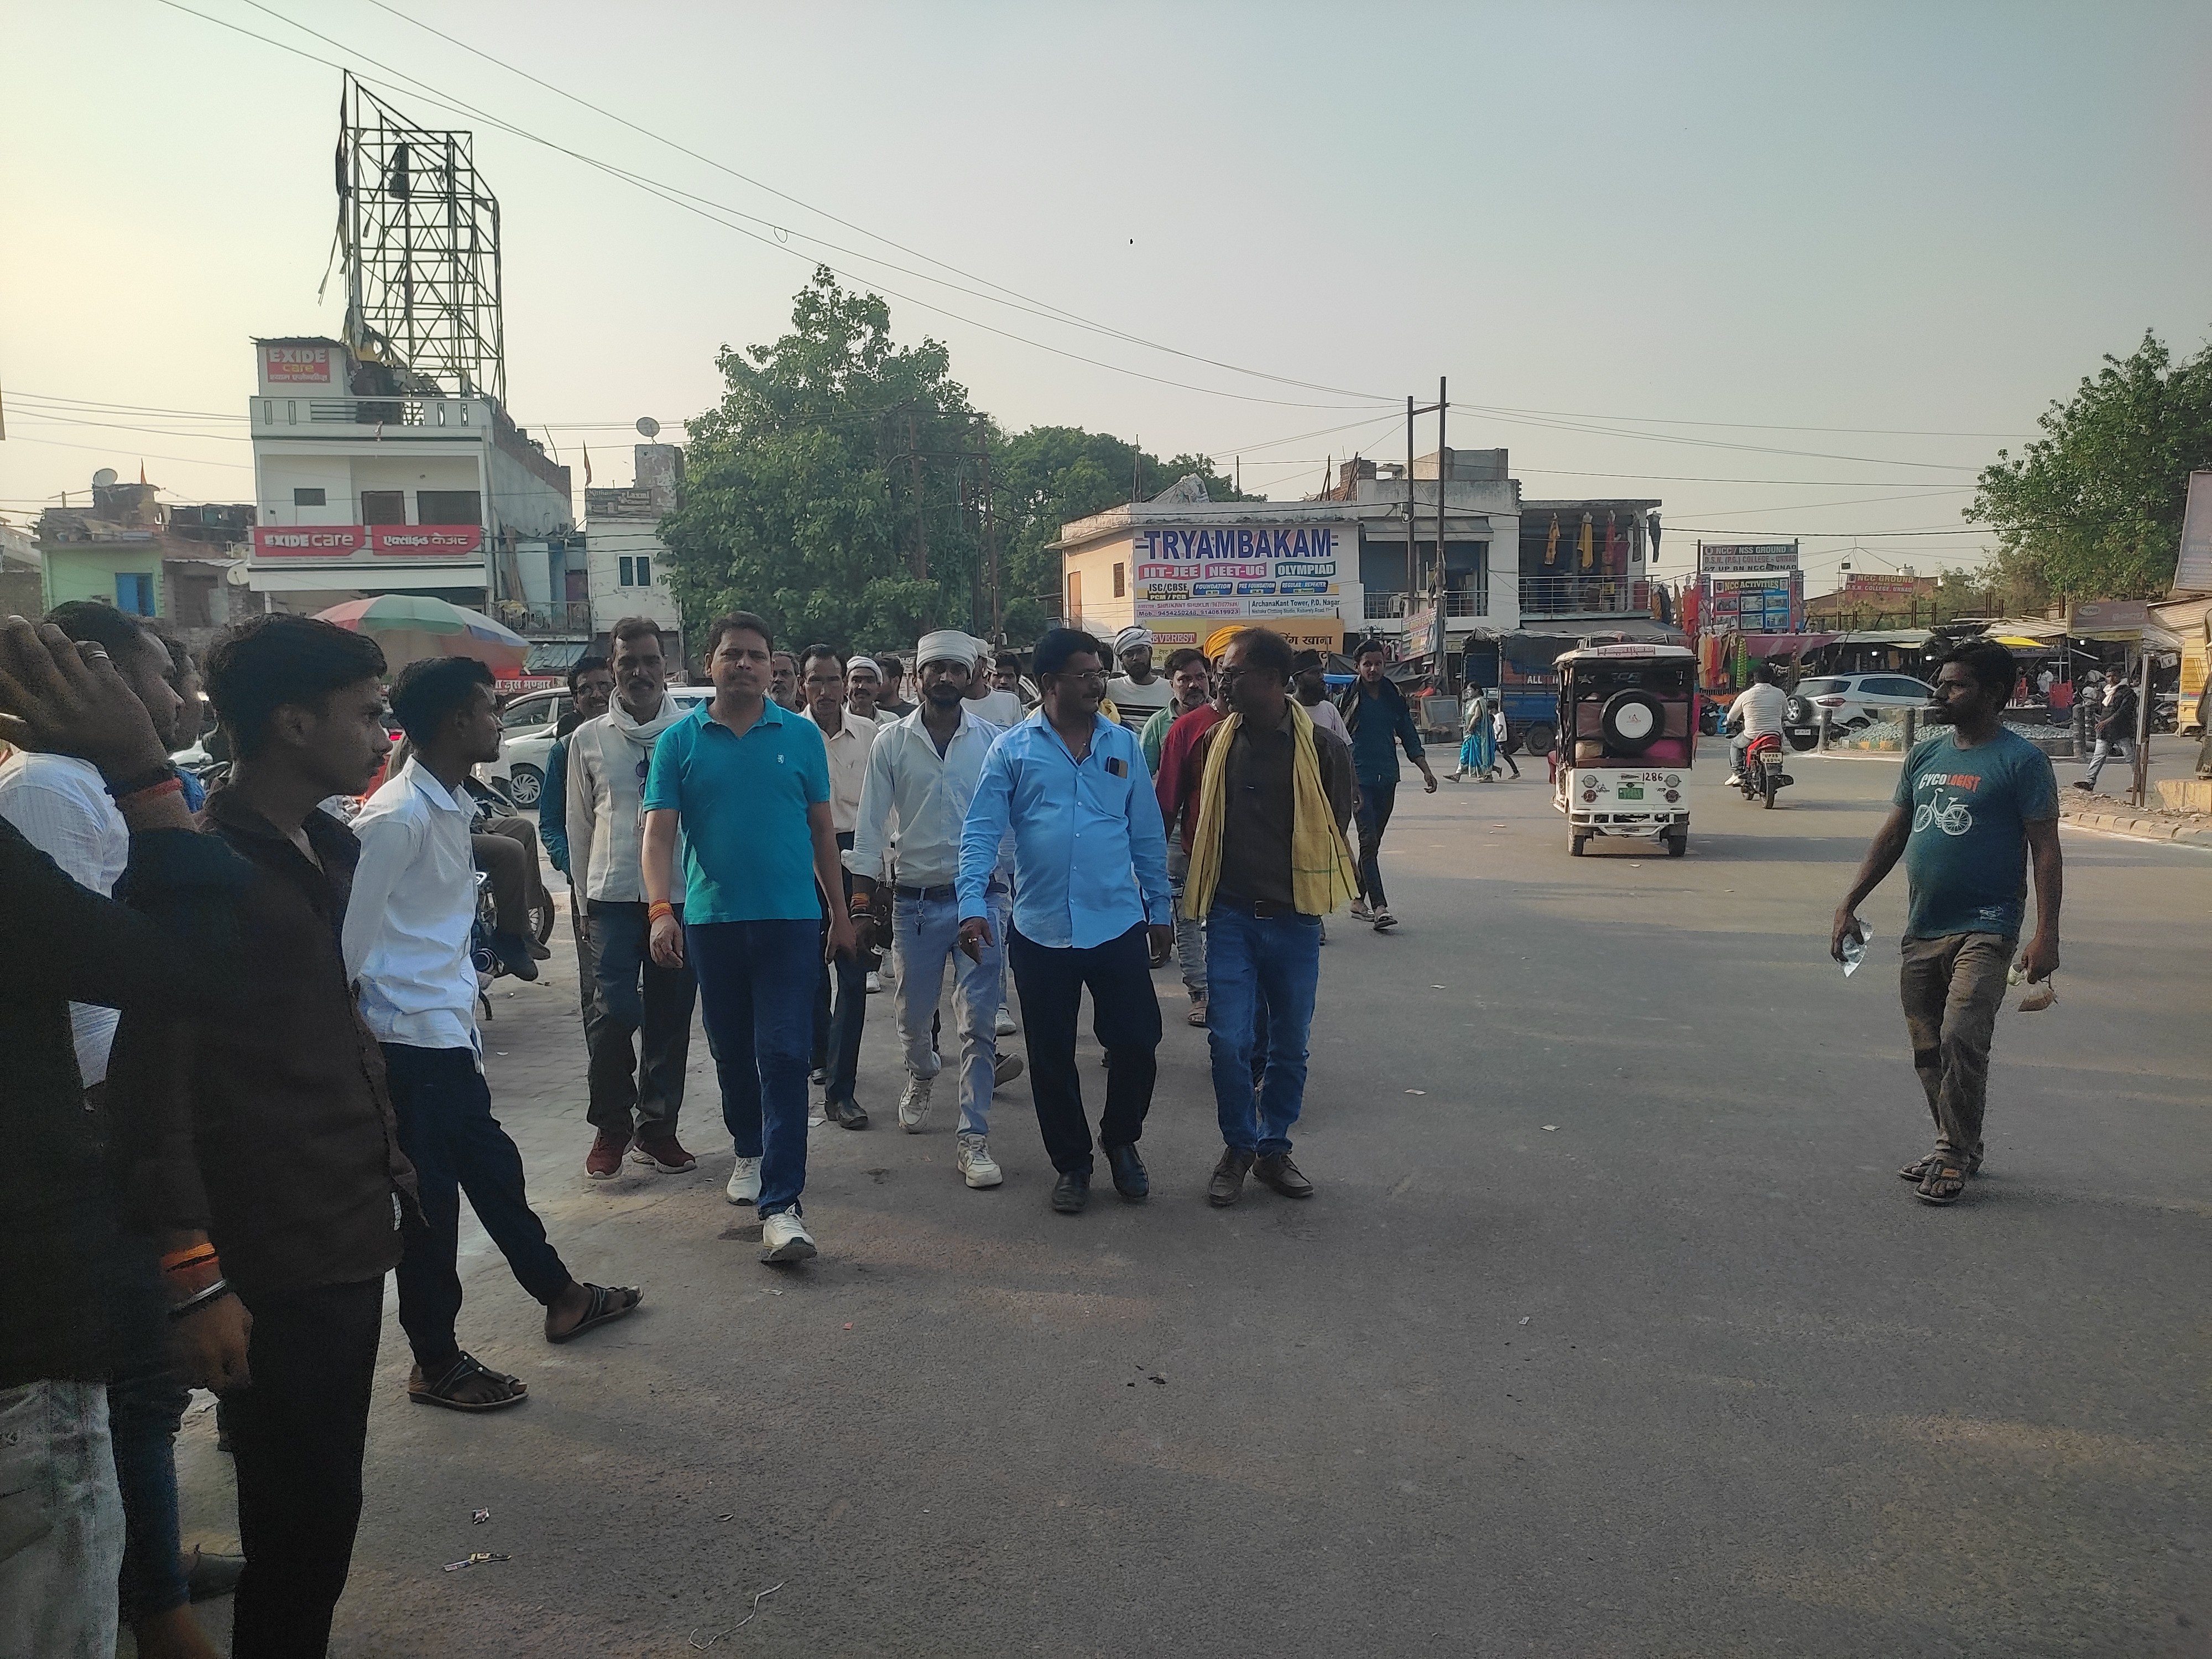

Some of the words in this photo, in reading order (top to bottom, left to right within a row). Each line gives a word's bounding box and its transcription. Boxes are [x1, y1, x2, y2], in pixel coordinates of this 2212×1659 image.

[269, 349, 326, 363] EXIDE
[283, 364, 314, 373] care
[264, 534, 309, 547] EXIDE
[311, 534, 354, 547] care
[1144, 529, 1332, 560] TRYAMBAKAM
[1144, 566, 1198, 577] IIT-JEE
[1209, 565, 1265, 576] NEET-UG
[1277, 564, 1334, 576] OLYMPIAD
[1149, 583, 1188, 592] ISC/CBSE
[1725, 581, 1739, 591] NCC
[1740, 580, 1779, 589] ACTIVITIES
[1322, 599, 1340, 607] Nagar
[1153, 633, 1195, 643] EVEREST
[1302, 636, 1333, 645] खाना
[1527, 675, 1543, 684] ALL
[1642, 772, 1663, 782] 1286
[1918, 774, 1981, 793] CYCOLOGIST
